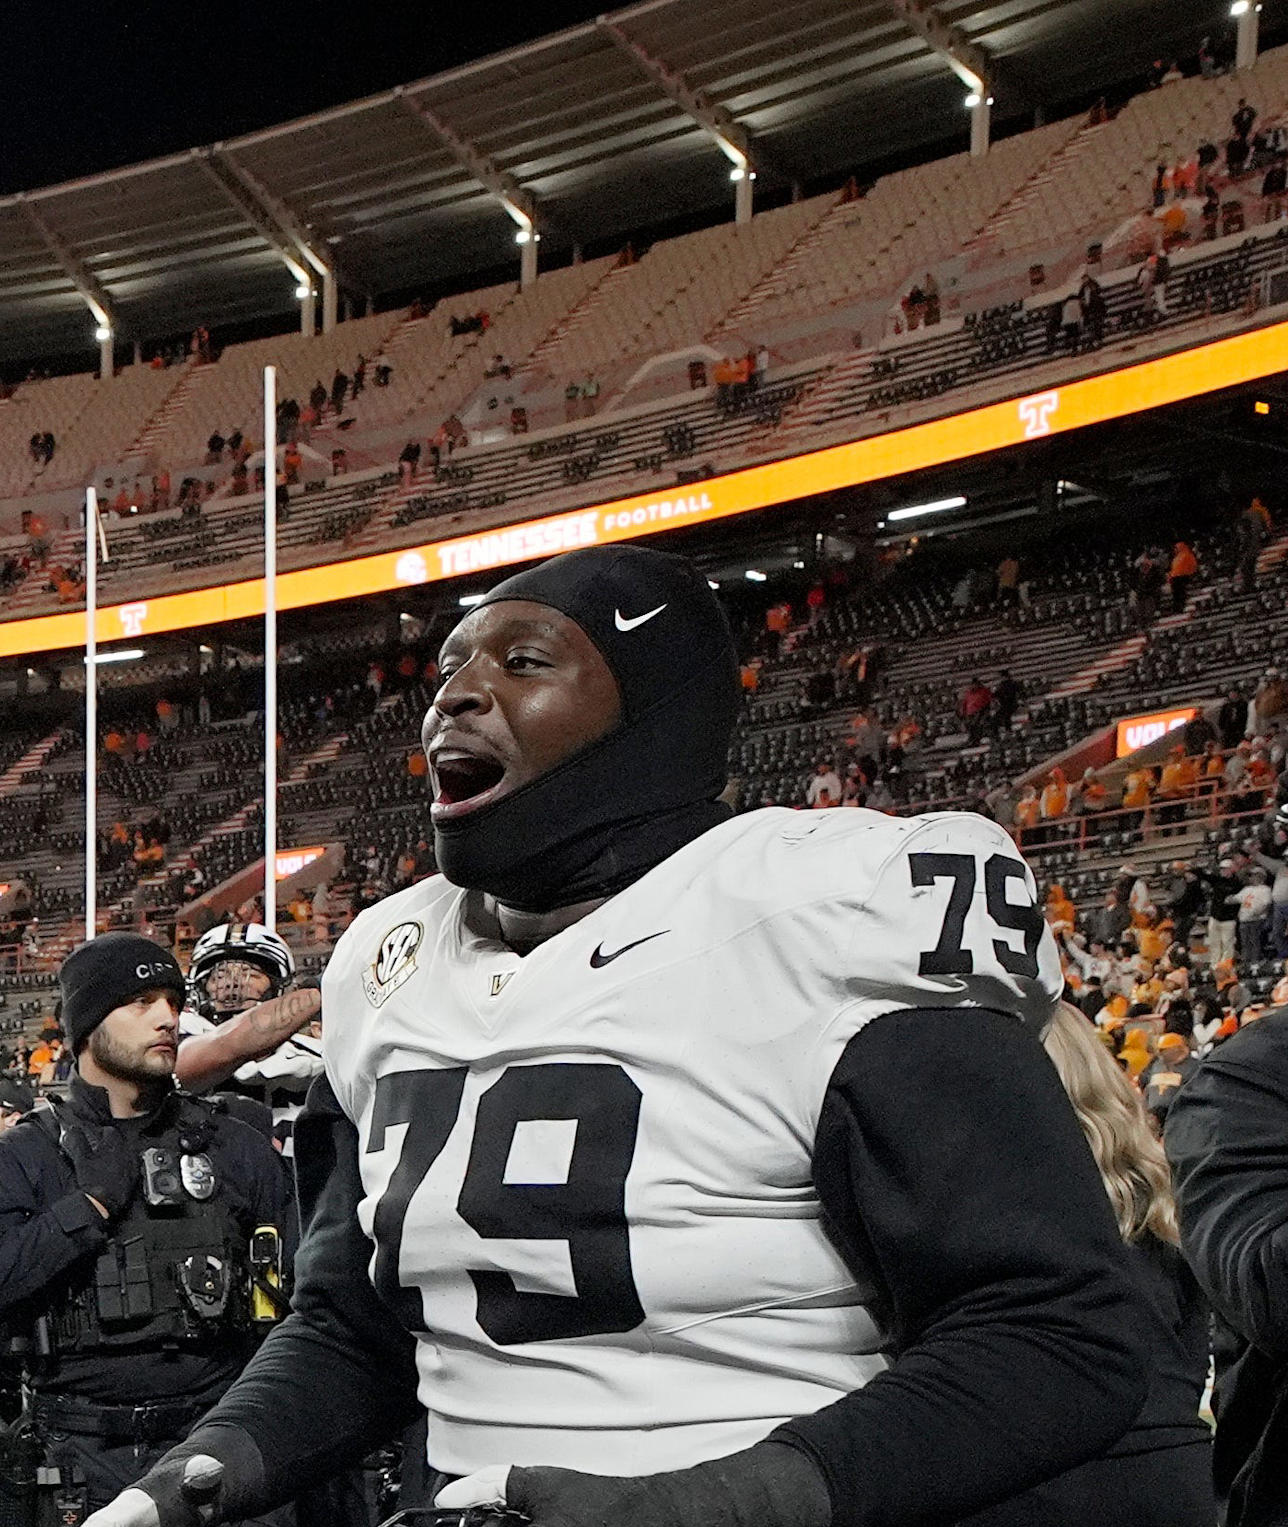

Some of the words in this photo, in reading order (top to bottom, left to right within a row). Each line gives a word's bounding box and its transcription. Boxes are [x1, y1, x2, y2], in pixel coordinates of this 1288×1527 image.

[1019, 391, 1058, 437] T
[438, 512, 599, 576] TENNESSEE
[604, 493, 713, 531] FOOTBALL
[120, 603, 147, 636] T
[908, 853, 1044, 979] 79
[366, 1062, 647, 1346] 79
